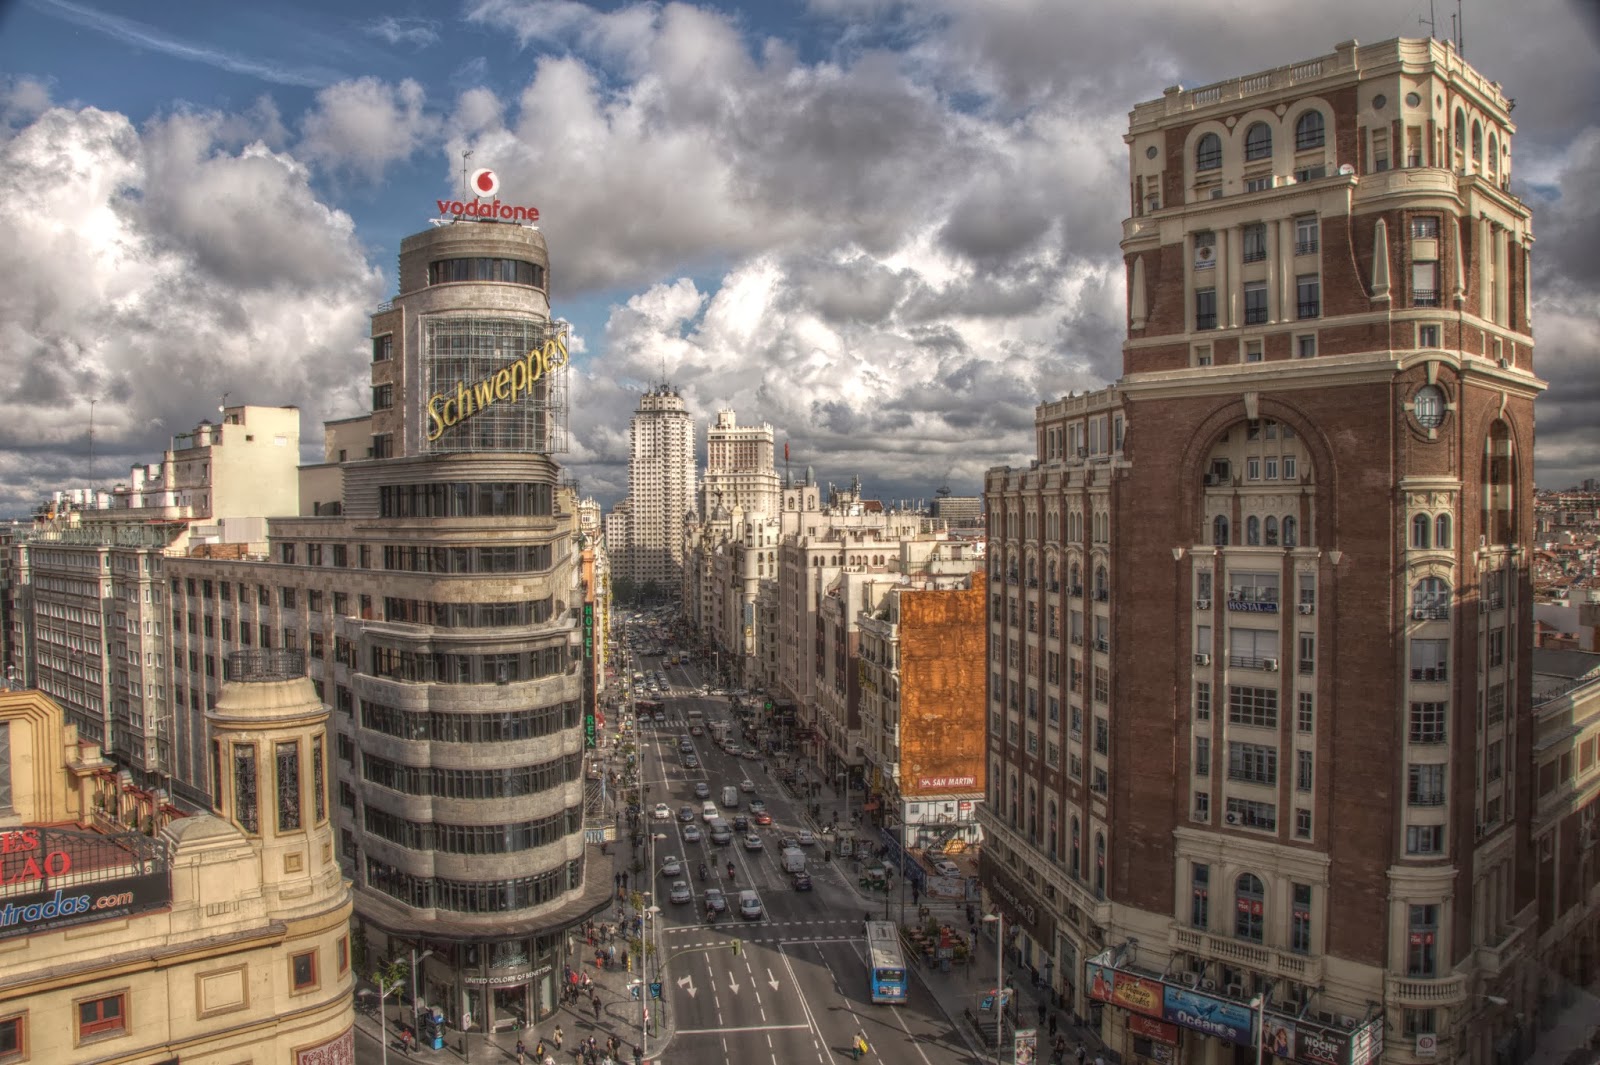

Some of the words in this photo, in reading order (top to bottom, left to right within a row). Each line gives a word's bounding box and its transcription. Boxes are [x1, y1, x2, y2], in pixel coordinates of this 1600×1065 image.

[437, 199, 539, 221] vodafone
[427, 331, 569, 441] Schweppes
[1229, 601, 1263, 611] HOSTAL
[585, 605, 593, 658] HOTEL
[586, 715, 595, 746] REX
[932, 778, 945, 786] SAN
[948, 777, 974, 785] MARTIN
[526, 964, 553, 979] BENETTON
[1304, 1036, 1338, 1054] NOCHE
[1308, 1047, 1335, 1061] LOCA
